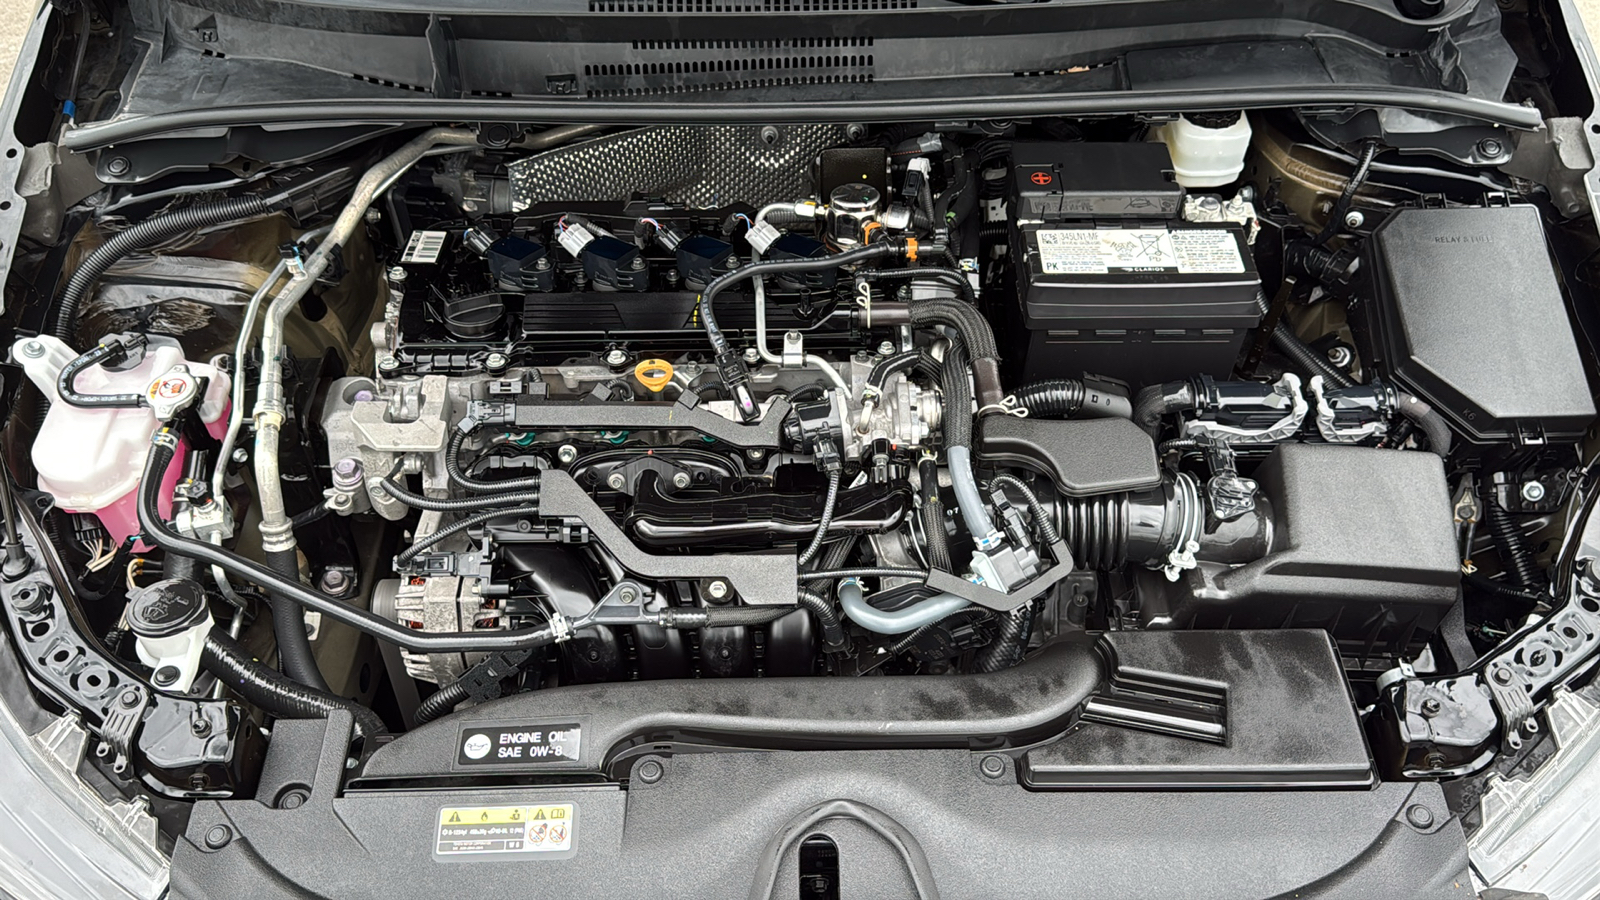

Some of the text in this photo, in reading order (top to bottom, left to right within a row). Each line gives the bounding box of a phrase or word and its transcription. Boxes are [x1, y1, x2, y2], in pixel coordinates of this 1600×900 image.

[1434, 236, 1460, 244] RELAY
[1046, 262, 1059, 271] PK
[499, 730, 568, 744] ENGINE OIL
[498, 745, 563, 758] SAE 0W-8
